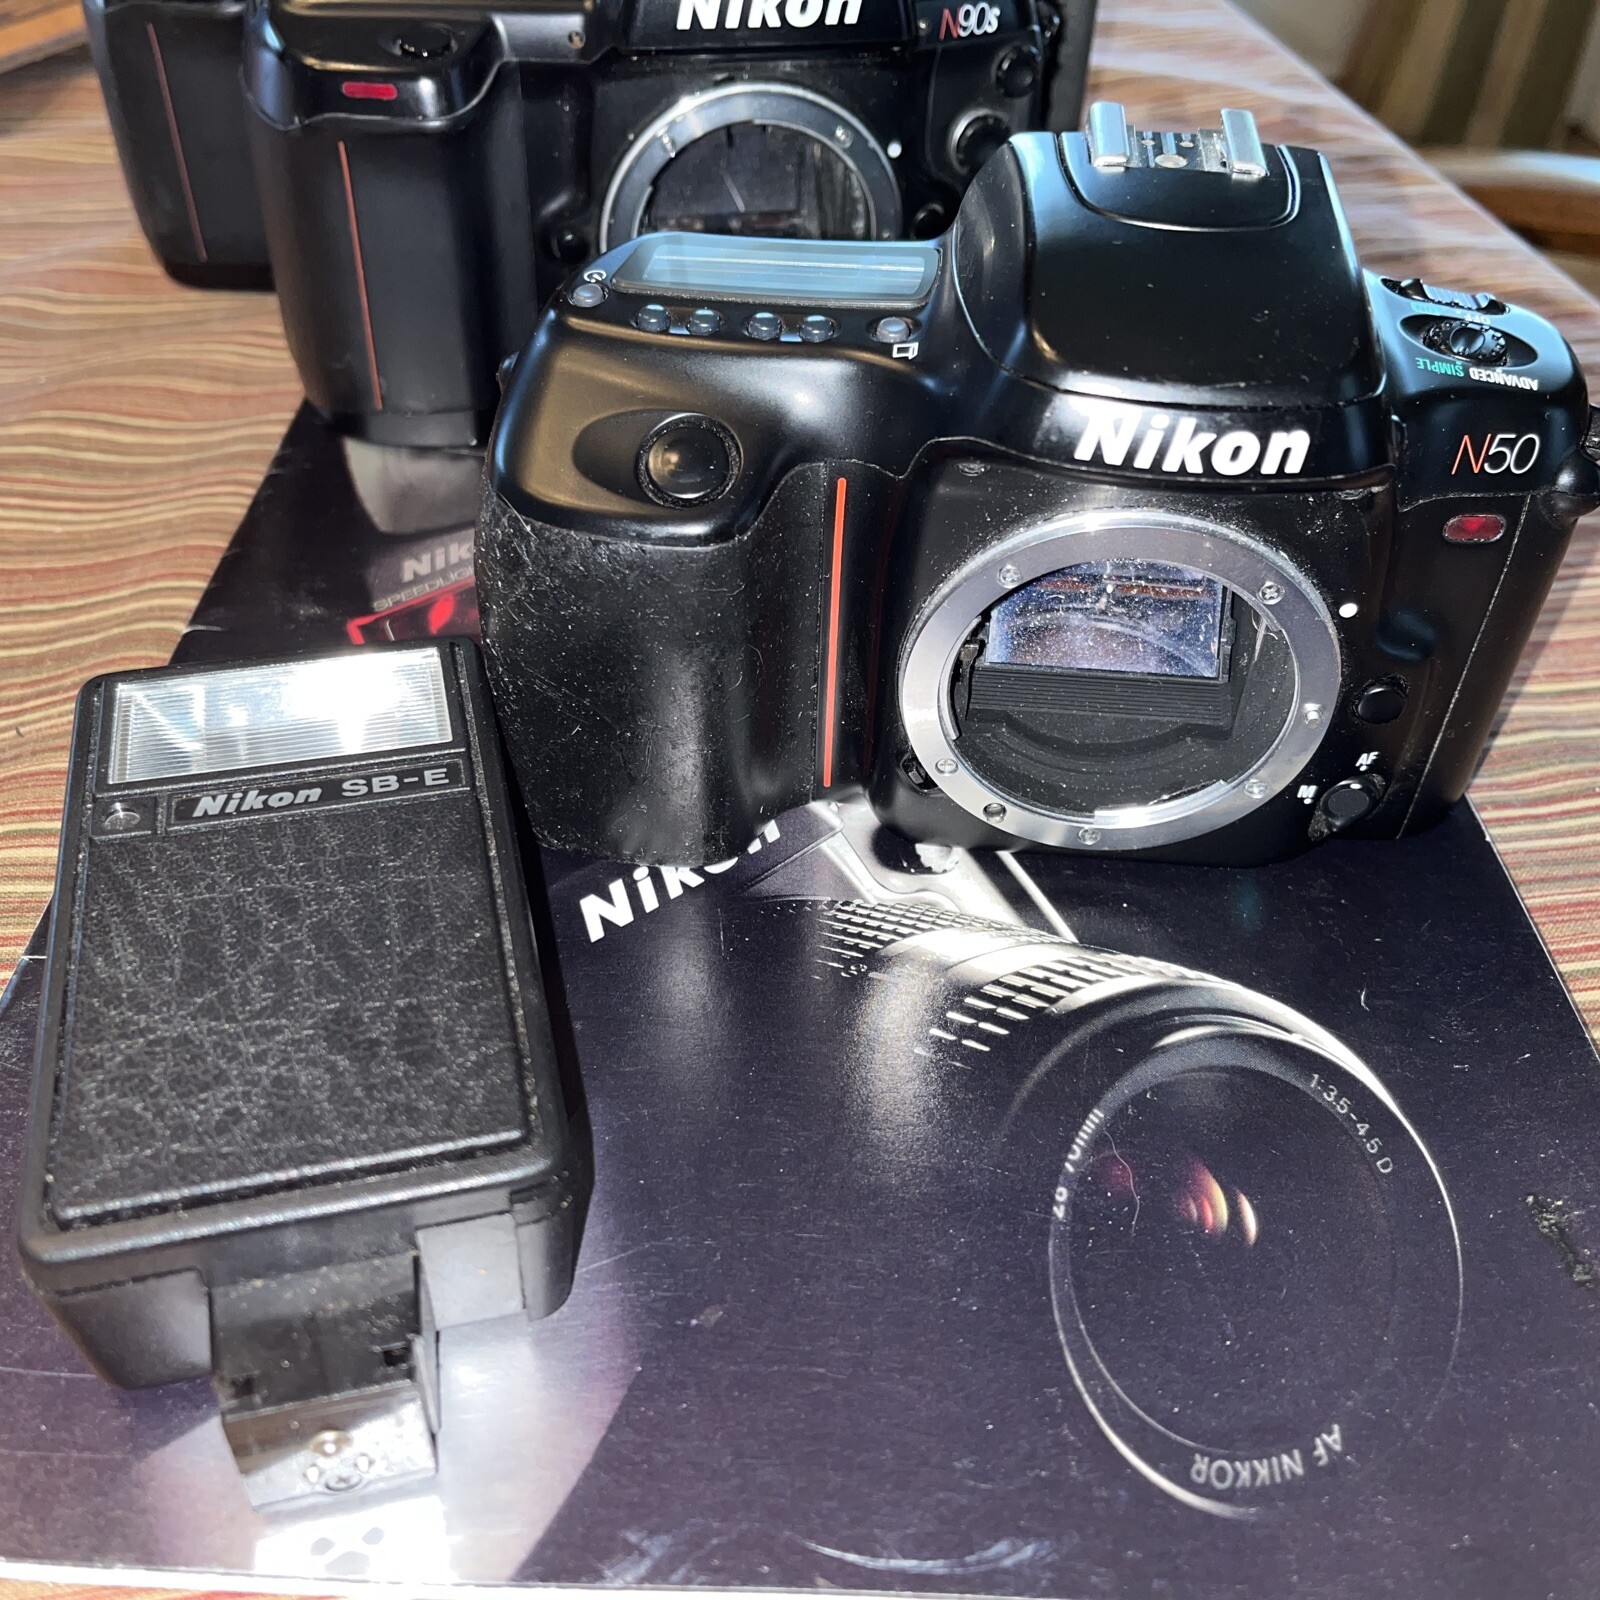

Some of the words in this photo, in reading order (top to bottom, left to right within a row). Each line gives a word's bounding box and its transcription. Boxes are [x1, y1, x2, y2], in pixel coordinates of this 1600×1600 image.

[676, 0, 863, 30] Nikon
[939, 2, 1000, 40] N90s
[1415, 357, 1464, 377] SIMPLE
[1468, 367, 1539, 391] ADVANCED
[1074, 403, 1311, 476] Nikon
[1451, 433, 1541, 475] N50
[402, 541, 474, 583] Nik
[1355, 752, 1379, 766] AF
[192, 787, 322, 818] Nikon
[341, 767, 451, 798] SB-E
[1296, 784, 1317, 798] M
[1310, 1073, 1383, 1154] 1:3.5-4.5
[1376, 1156, 1394, 1174] D
[1313, 1423, 1343, 1467] AF
[1190, 1448, 1305, 1490] NIKKOR
